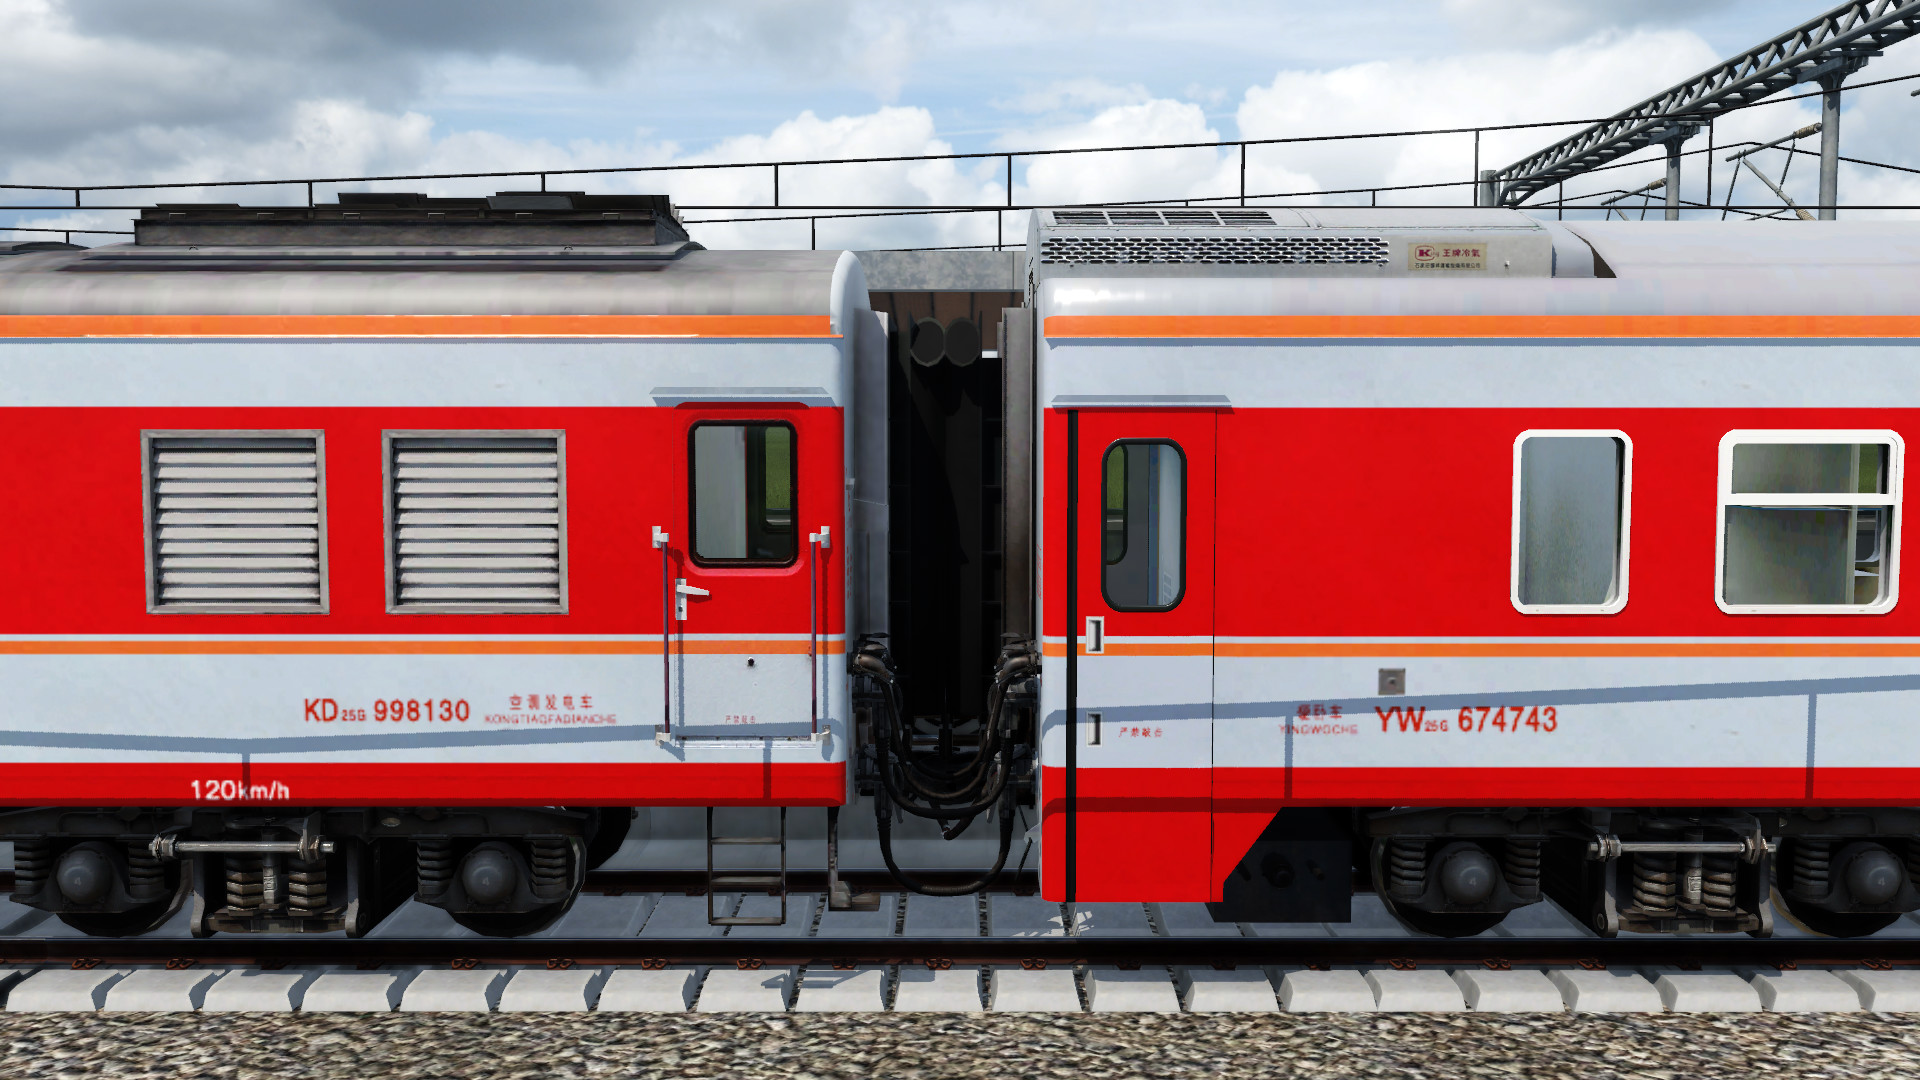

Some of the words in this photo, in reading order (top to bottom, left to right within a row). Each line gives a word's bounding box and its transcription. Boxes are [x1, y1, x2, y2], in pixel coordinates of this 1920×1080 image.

[374, 698, 470, 722] 998130
[509, 693, 593, 710] 空调发电车
[1458, 705, 1558, 733] 674743
